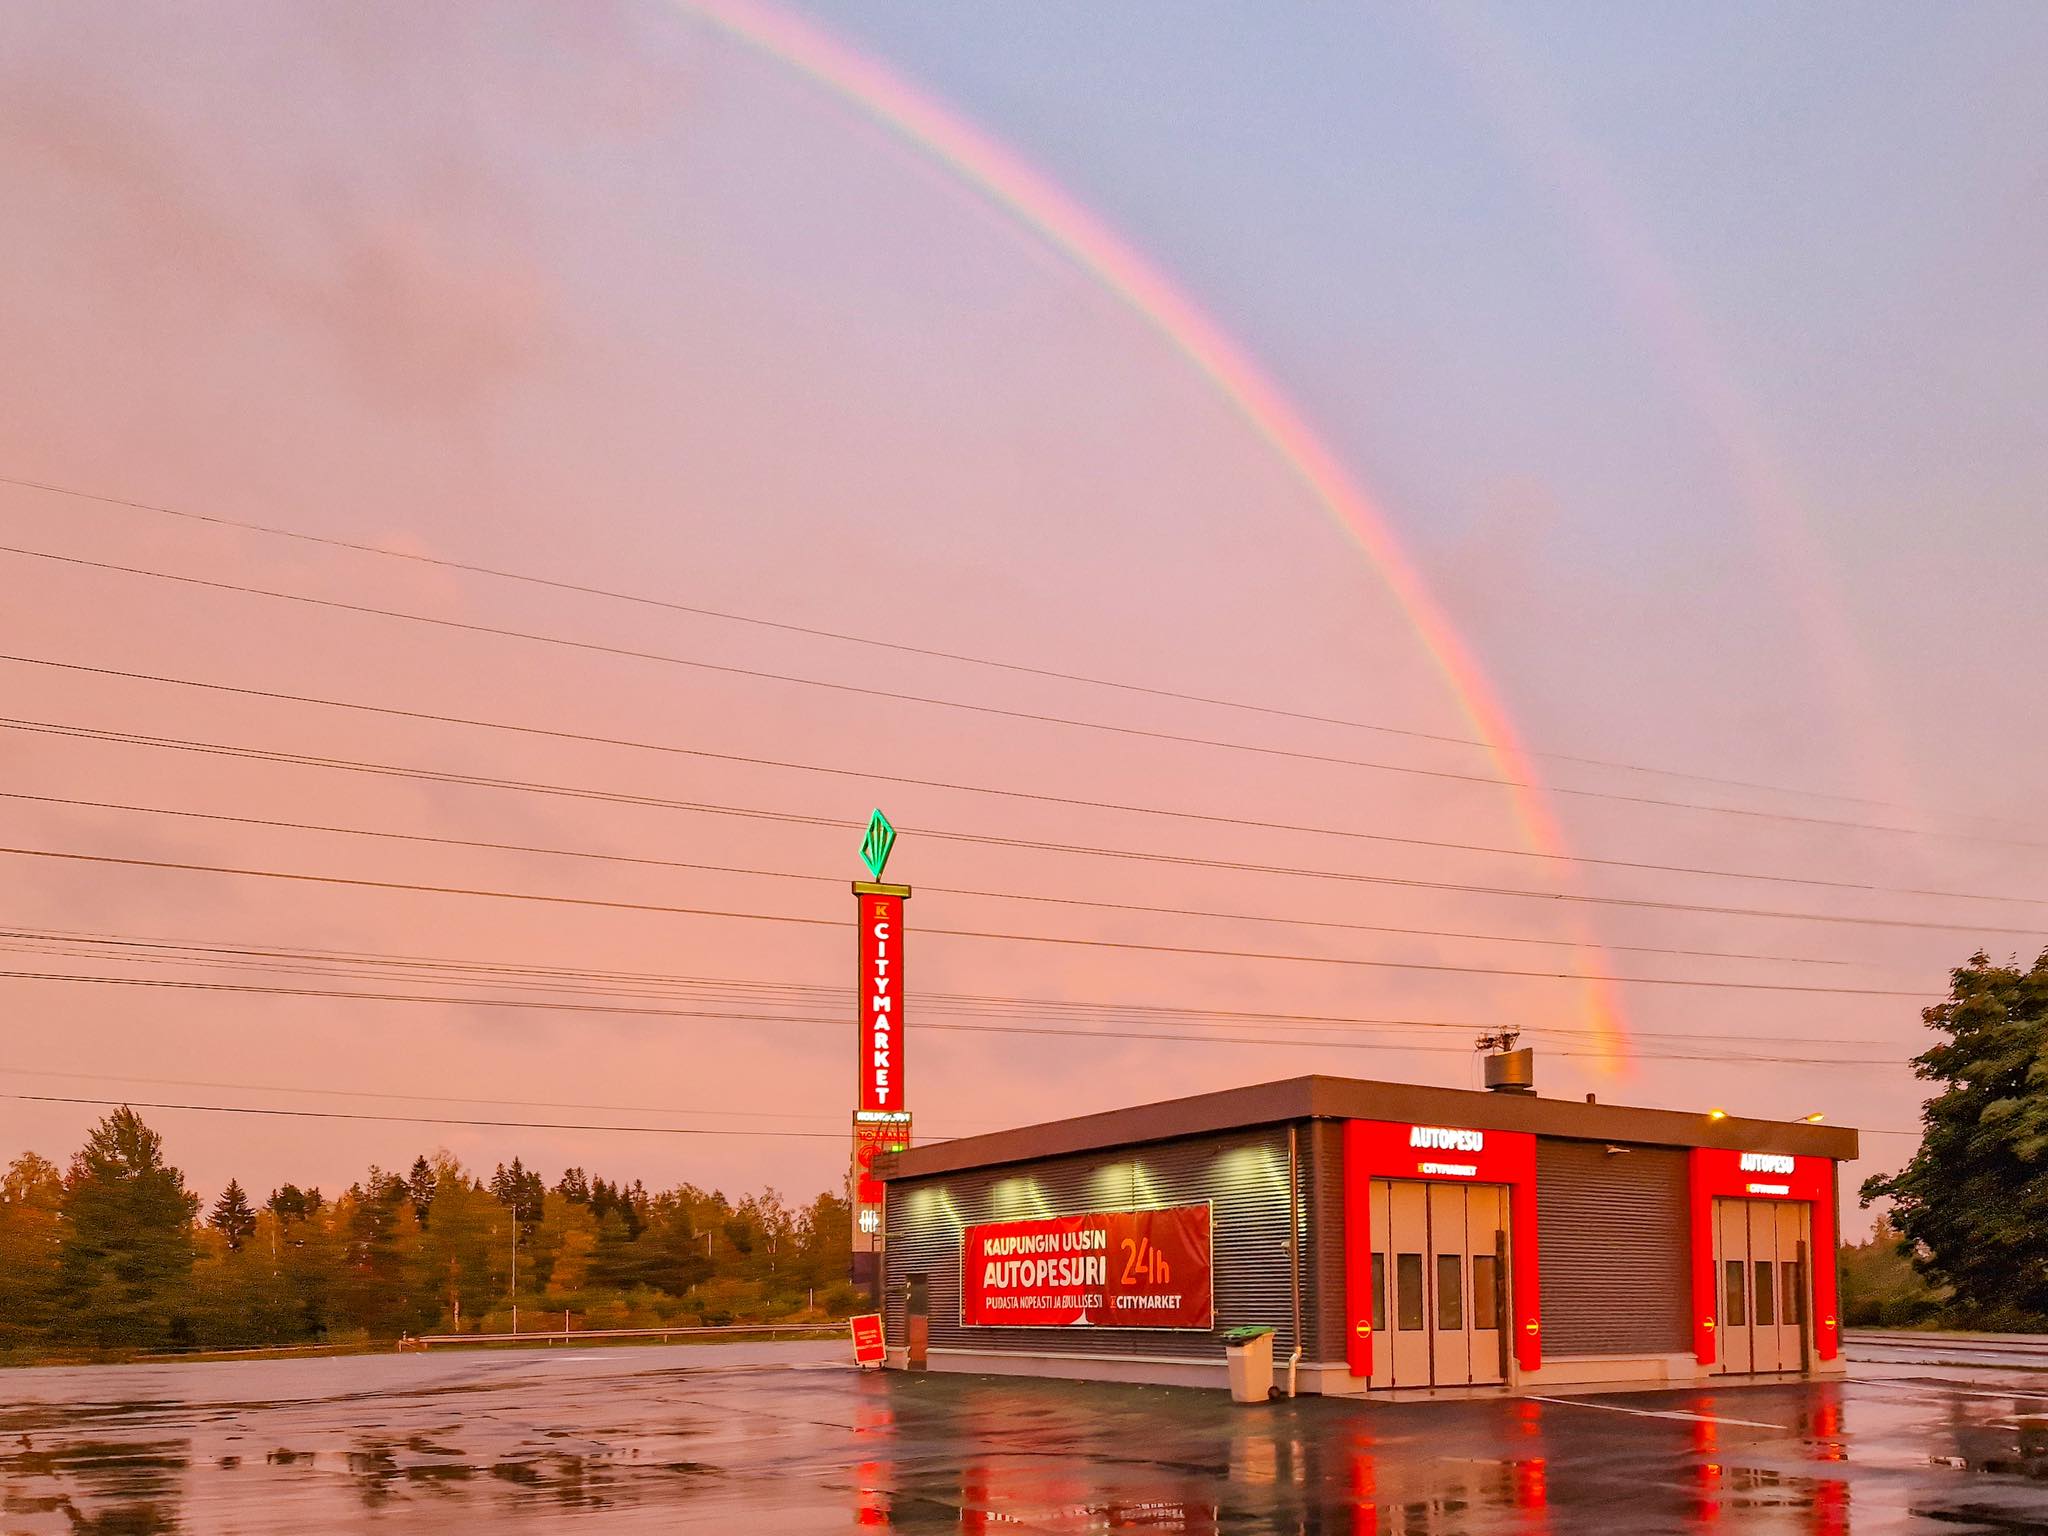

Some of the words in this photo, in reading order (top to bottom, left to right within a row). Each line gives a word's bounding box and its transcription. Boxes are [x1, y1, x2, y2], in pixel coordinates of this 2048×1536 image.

[873, 923, 891, 1105] CITYMARKET
[1410, 1126, 1483, 1152] AUTOPESU
[1740, 1153, 1795, 1175] AUTOPESU
[984, 1233, 1060, 1256] KAUPUNGIN
[1062, 1229, 1106, 1252] UUSIN
[983, 1255, 1106, 1288] AUTOPESURI
[1121, 1237, 1170, 1285] 24h
[1116, 1295, 1182, 1309] CITYMARKET
